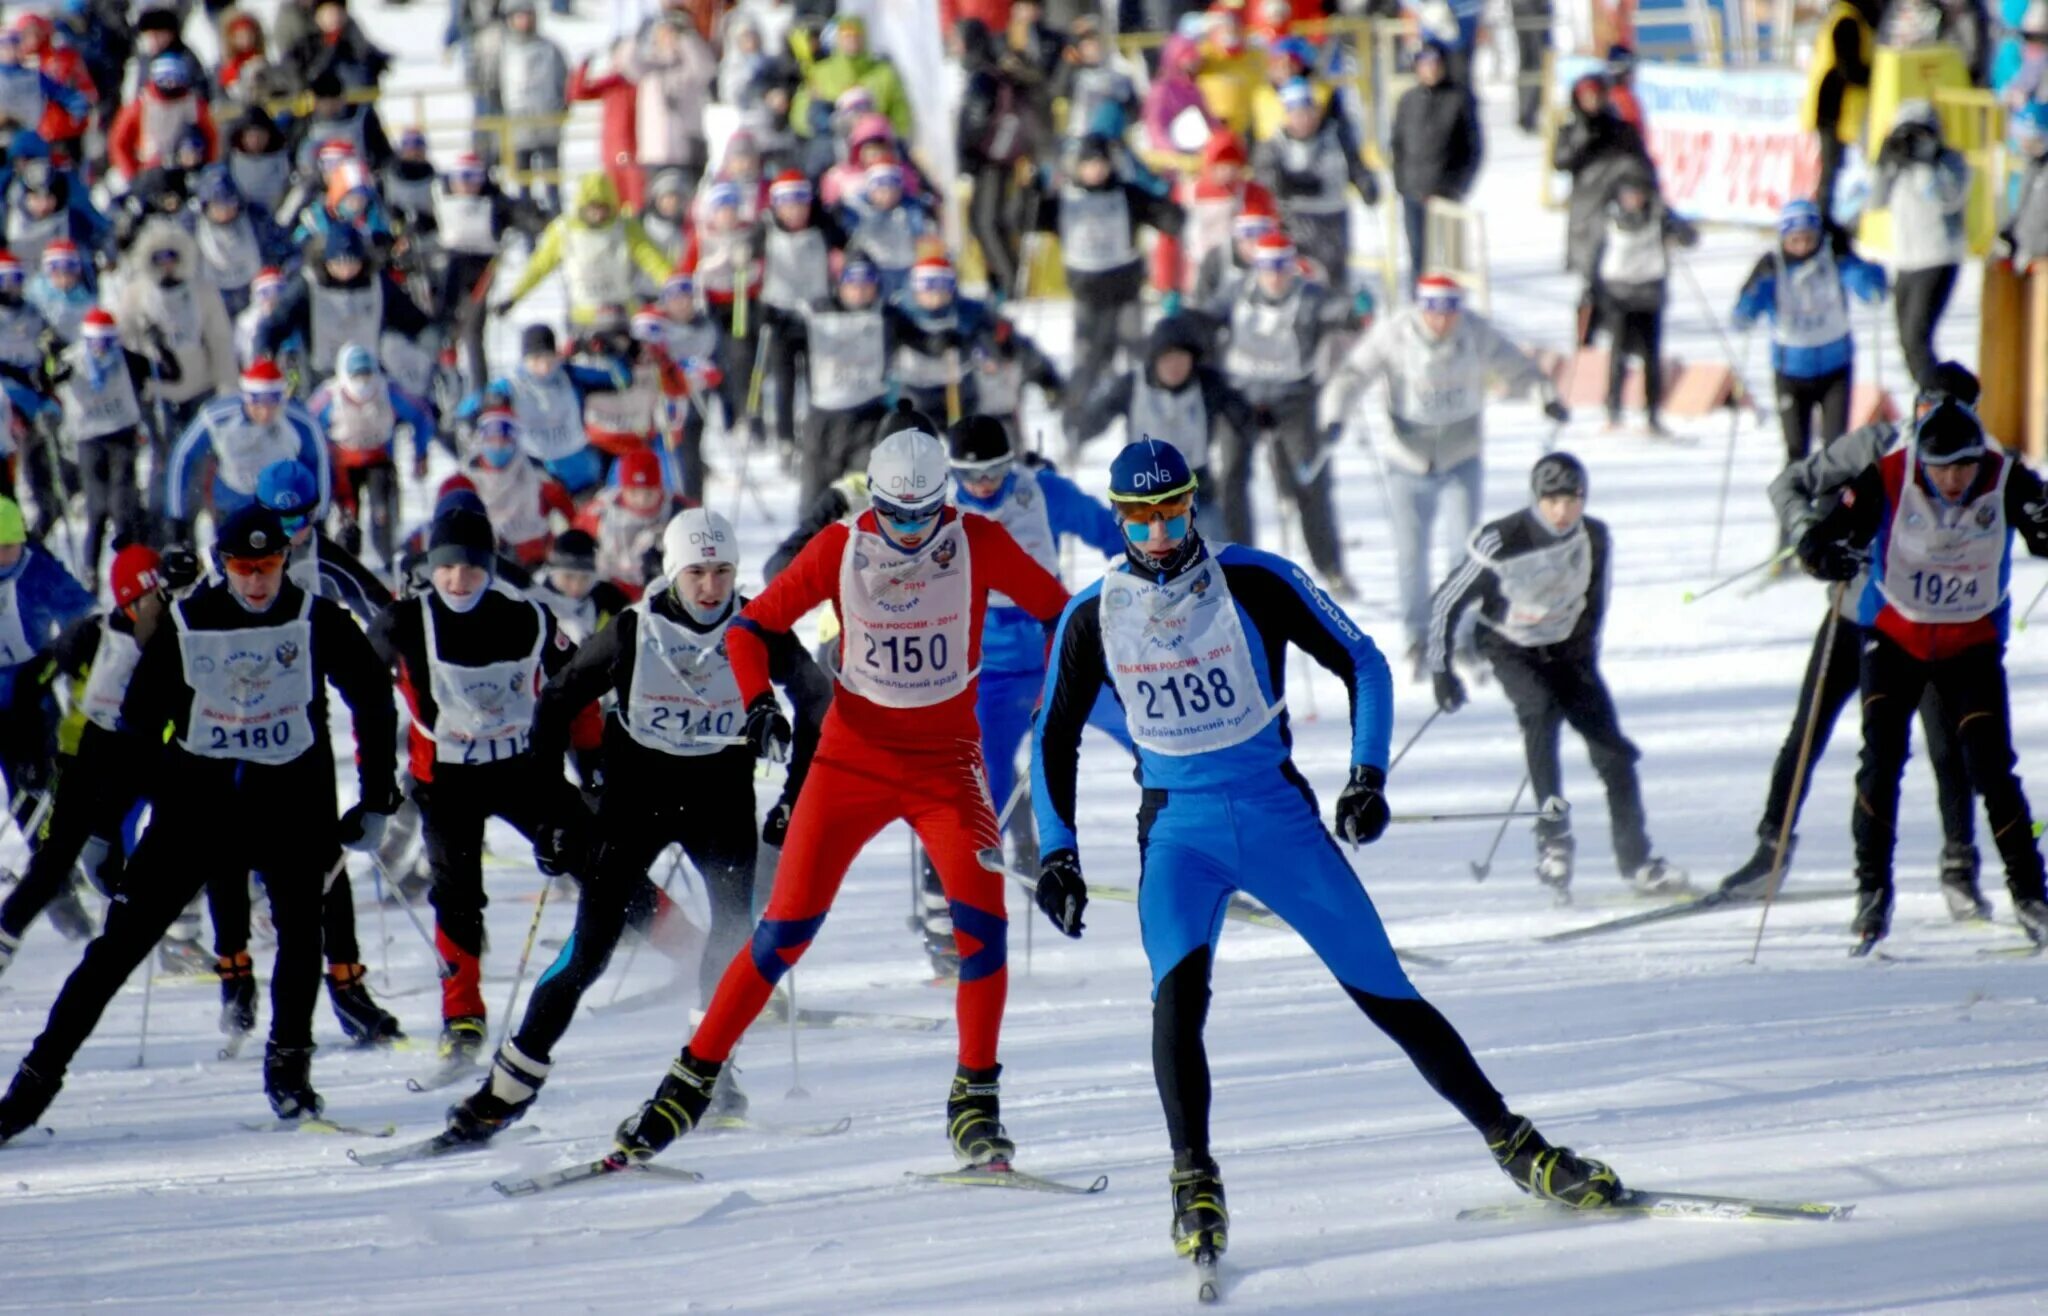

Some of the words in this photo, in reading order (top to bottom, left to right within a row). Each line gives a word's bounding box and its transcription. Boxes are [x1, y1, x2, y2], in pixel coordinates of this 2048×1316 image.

[891, 475, 927, 494] DNB
[1133, 461, 1172, 489] DNB
[688, 529, 726, 547] DNB
[1909, 571, 1978, 605] 1924
[877, 597, 920, 613] РОССИИ
[886, 621, 928, 630] РОССИИ
[863, 632, 948, 674] 2150
[1151, 634, 1185, 651] РОССИИ
[1116, 660, 1158, 674] ЛЫЖНЯ
[1160, 657, 1200, 672] РОССИИ
[1207, 643, 1233, 662] 2014
[1136, 667, 1236, 720] 2138
[211, 720, 290, 749] 2180
[650, 706, 734, 735] 2140
[1138, 717, 1225, 739] Забайкальский
